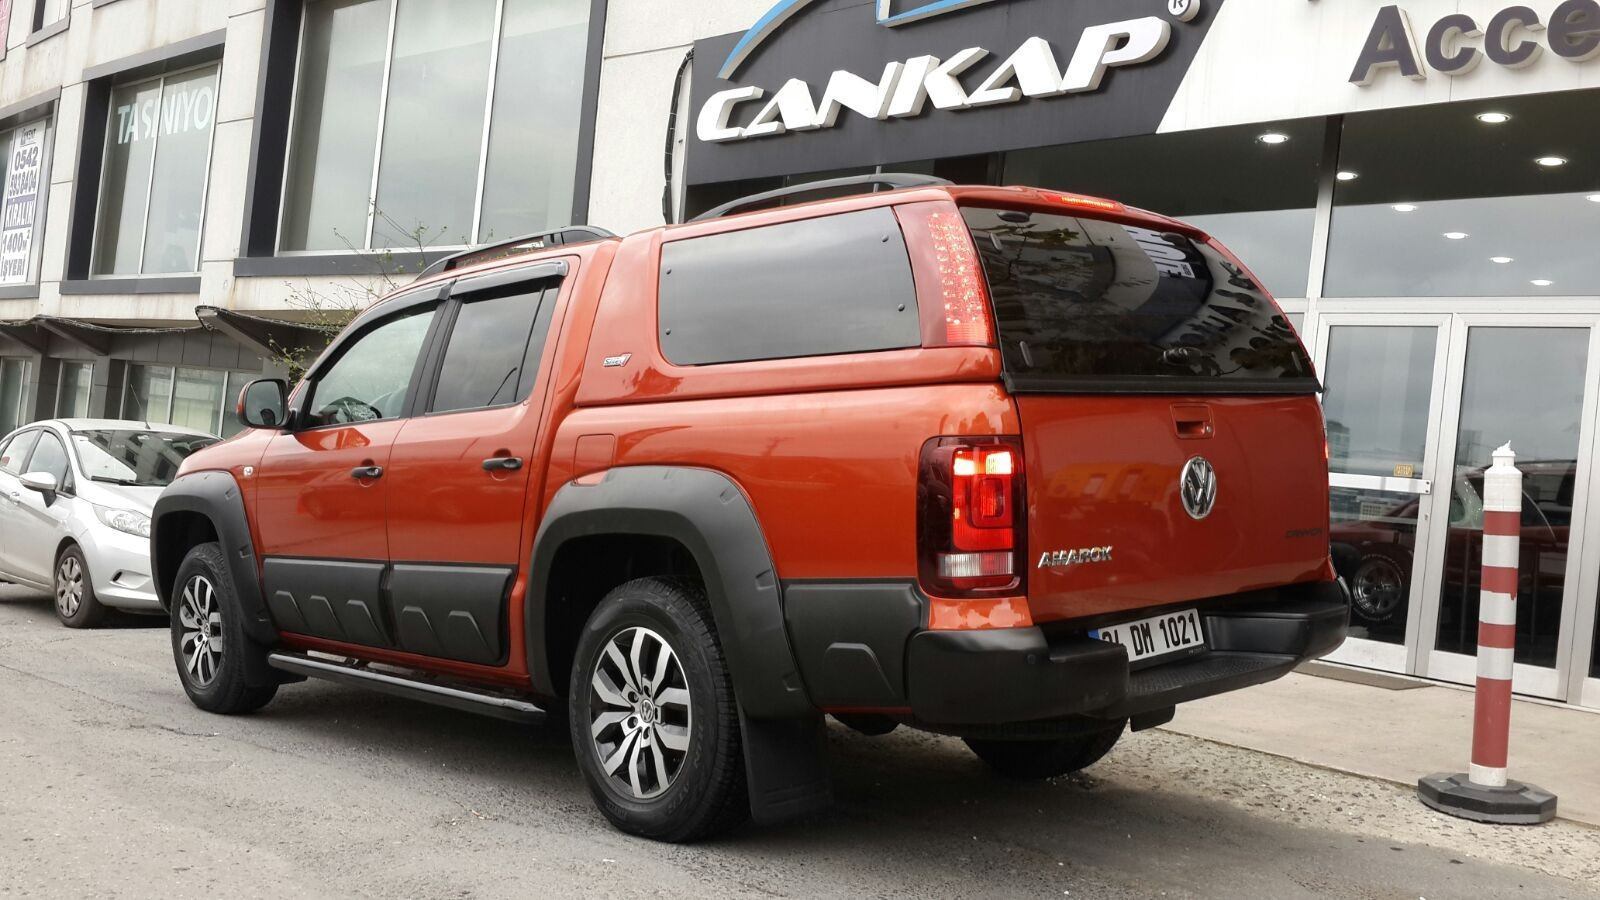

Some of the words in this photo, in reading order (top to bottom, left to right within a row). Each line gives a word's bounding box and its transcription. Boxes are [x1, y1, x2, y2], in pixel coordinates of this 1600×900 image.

[697, 15, 1172, 143] CANKAP
[14, 146, 39, 171] 0542
[1037, 545, 1113, 568] AMAROK
[1129, 622, 1155, 656] DM
[1159, 613, 1199, 648] 1021
